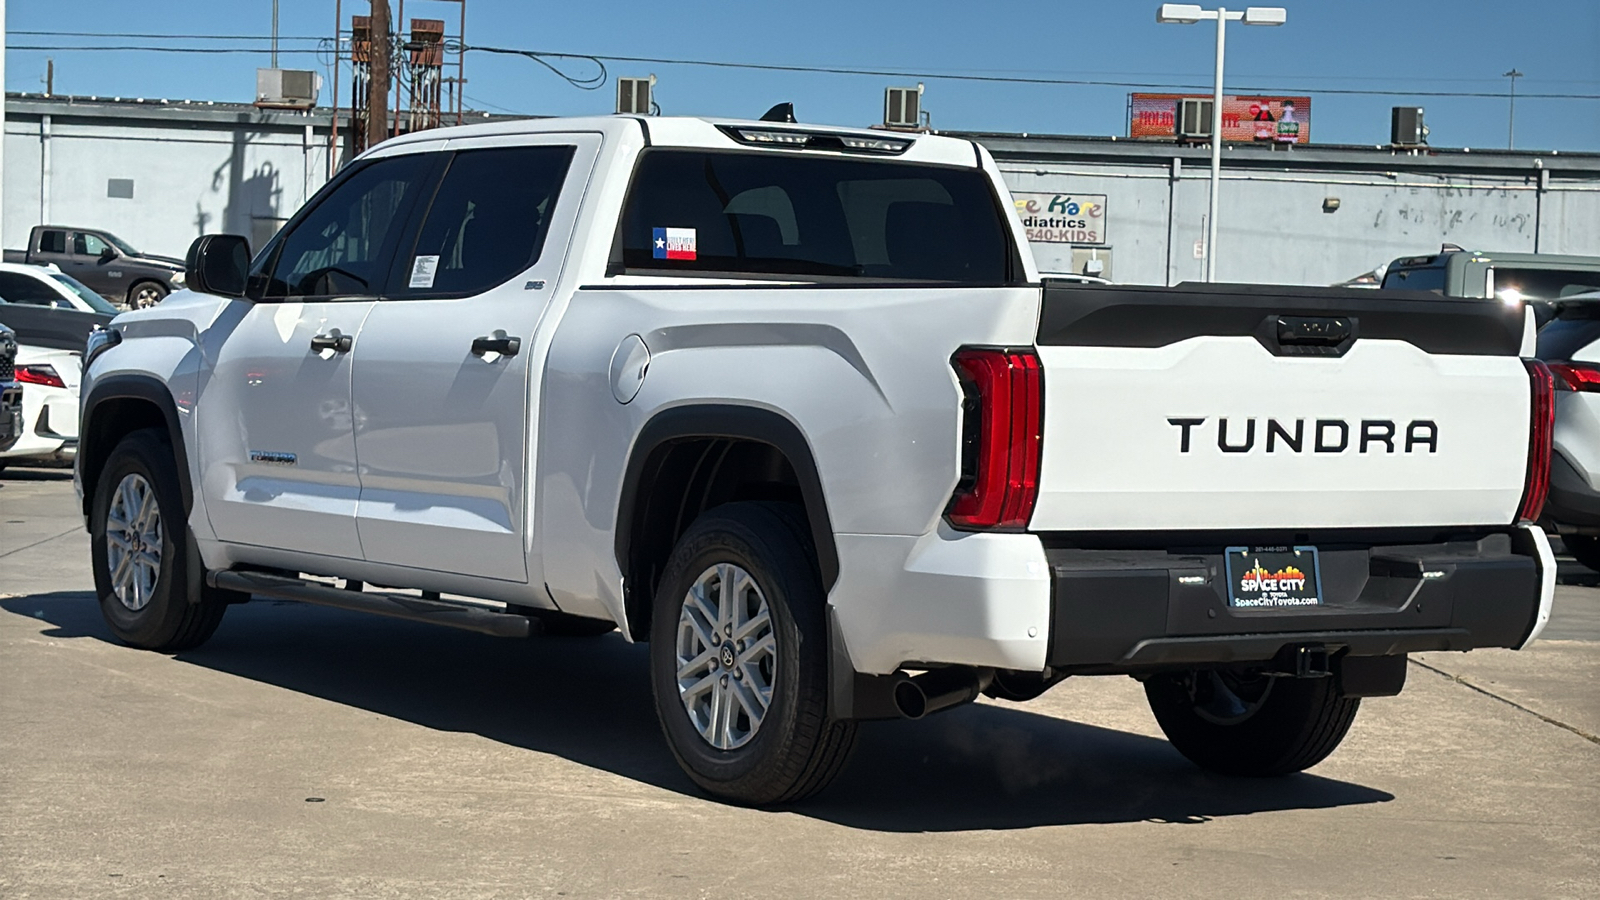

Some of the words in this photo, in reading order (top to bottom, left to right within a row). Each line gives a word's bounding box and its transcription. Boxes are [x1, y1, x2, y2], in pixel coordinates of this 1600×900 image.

[1048, 195, 1102, 218] Kare
[1020, 216, 1086, 228] diatrics
[1166, 418, 1438, 453] TUNDRA
[1241, 578, 1278, 592] SPACE
[1279, 578, 1306, 591] CITY
[1234, 597, 1318, 607] SpaceCityToyota.com
